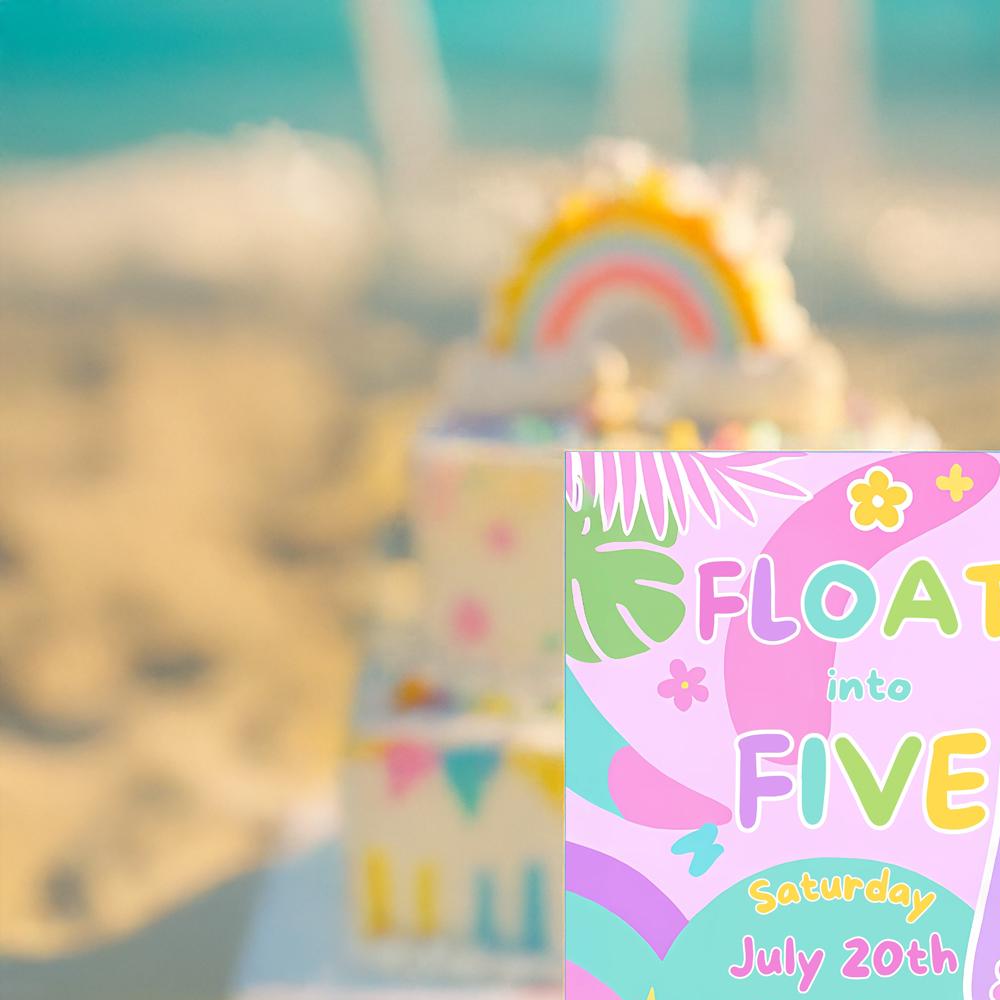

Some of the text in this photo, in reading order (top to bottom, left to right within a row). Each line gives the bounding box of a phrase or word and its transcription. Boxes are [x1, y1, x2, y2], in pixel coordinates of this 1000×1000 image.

[827, 668, 911, 701] into
[734, 728, 990, 834] FIVE
[748, 866, 937, 924] Saturday
[728, 931, 959, 993] July 20th
